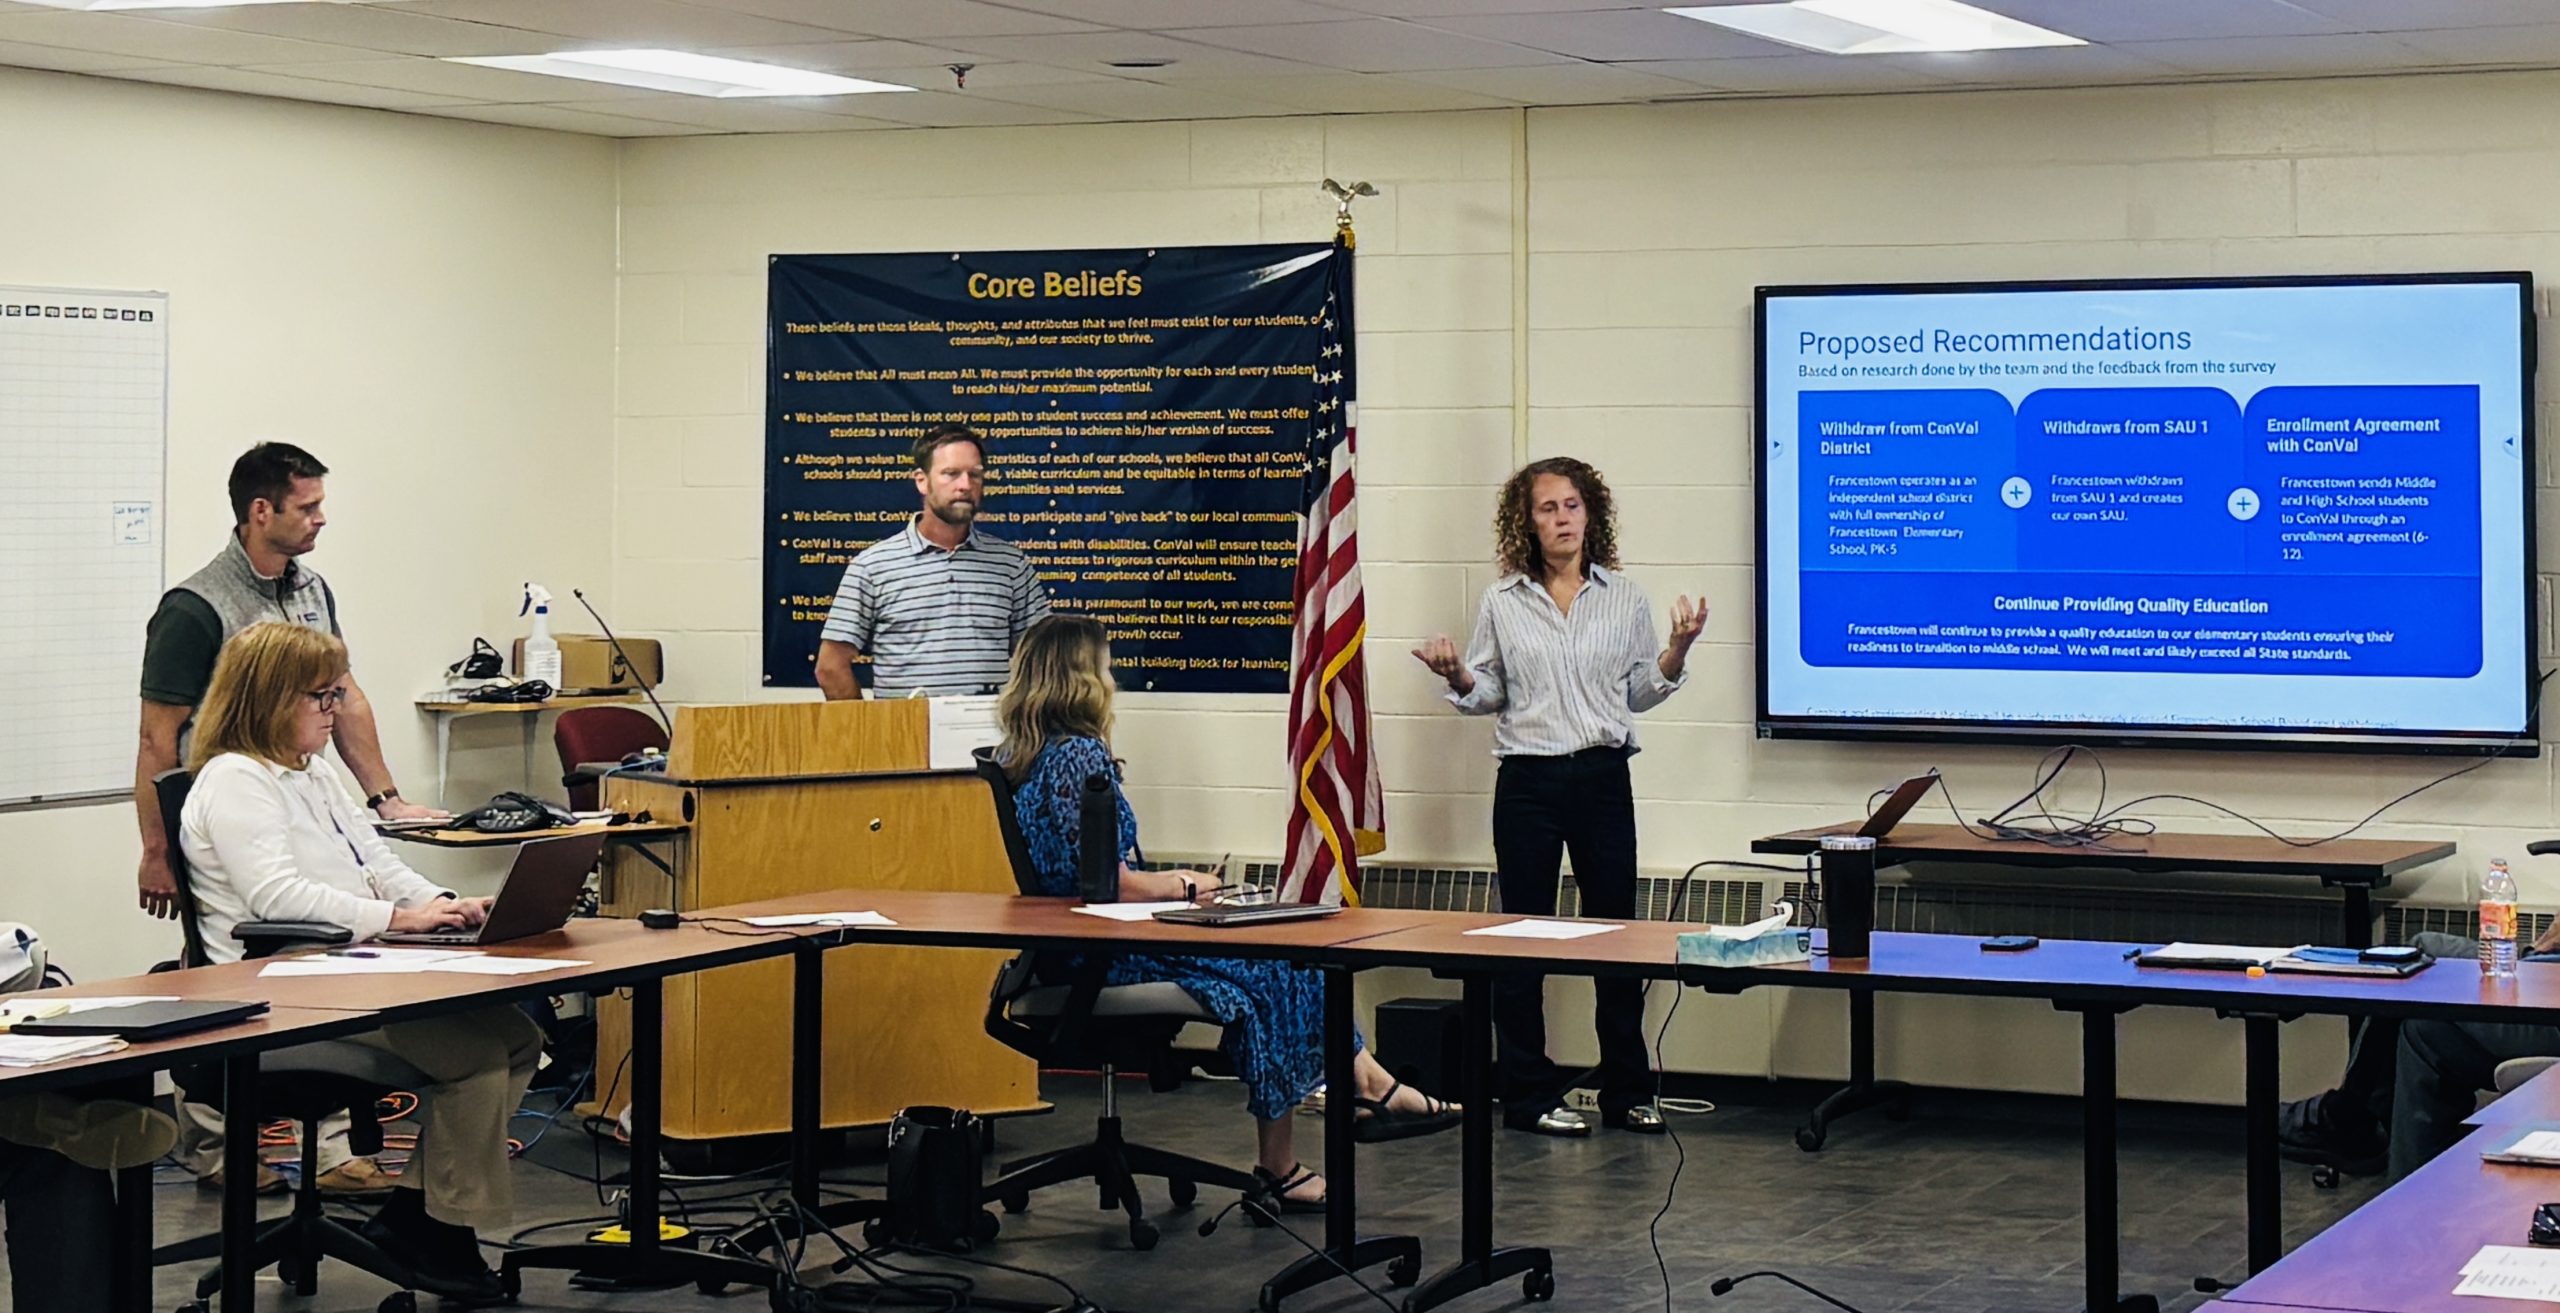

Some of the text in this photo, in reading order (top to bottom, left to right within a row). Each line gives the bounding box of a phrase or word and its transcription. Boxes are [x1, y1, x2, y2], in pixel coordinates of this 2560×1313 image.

[967, 269, 1143, 299] Core Beliefs
[1799, 326, 2193, 360] Proposed Recommendations
[1798, 359, 2277, 377] Based on research done by the team and the feedback from the survey
[794, 412, 815, 423] We
[814, 412, 856, 423] believe
[855, 412, 879, 423] that
[992, 411, 1021, 424] path
[1020, 412, 1035, 422] to
[1035, 410, 1079, 422] student
[1080, 412, 1125, 421] success
[1124, 410, 1149, 421] and
[1227, 408, 1248, 420] We
[1249, 409, 1280, 420] must
[1819, 420, 1979, 436] Withdraw from ConVal
[2043, 420, 2121, 434] Withdraws
[2124, 419, 2160, 434] from
[2164, 420, 2197, 434] SAU
[2267, 418, 2440, 435] Enrollment Agreement
[1820, 441, 1871, 454] District
[2266, 438, 2359, 452] with ConVal
[1994, 596, 2269, 616] Continue Providing Quality Education
